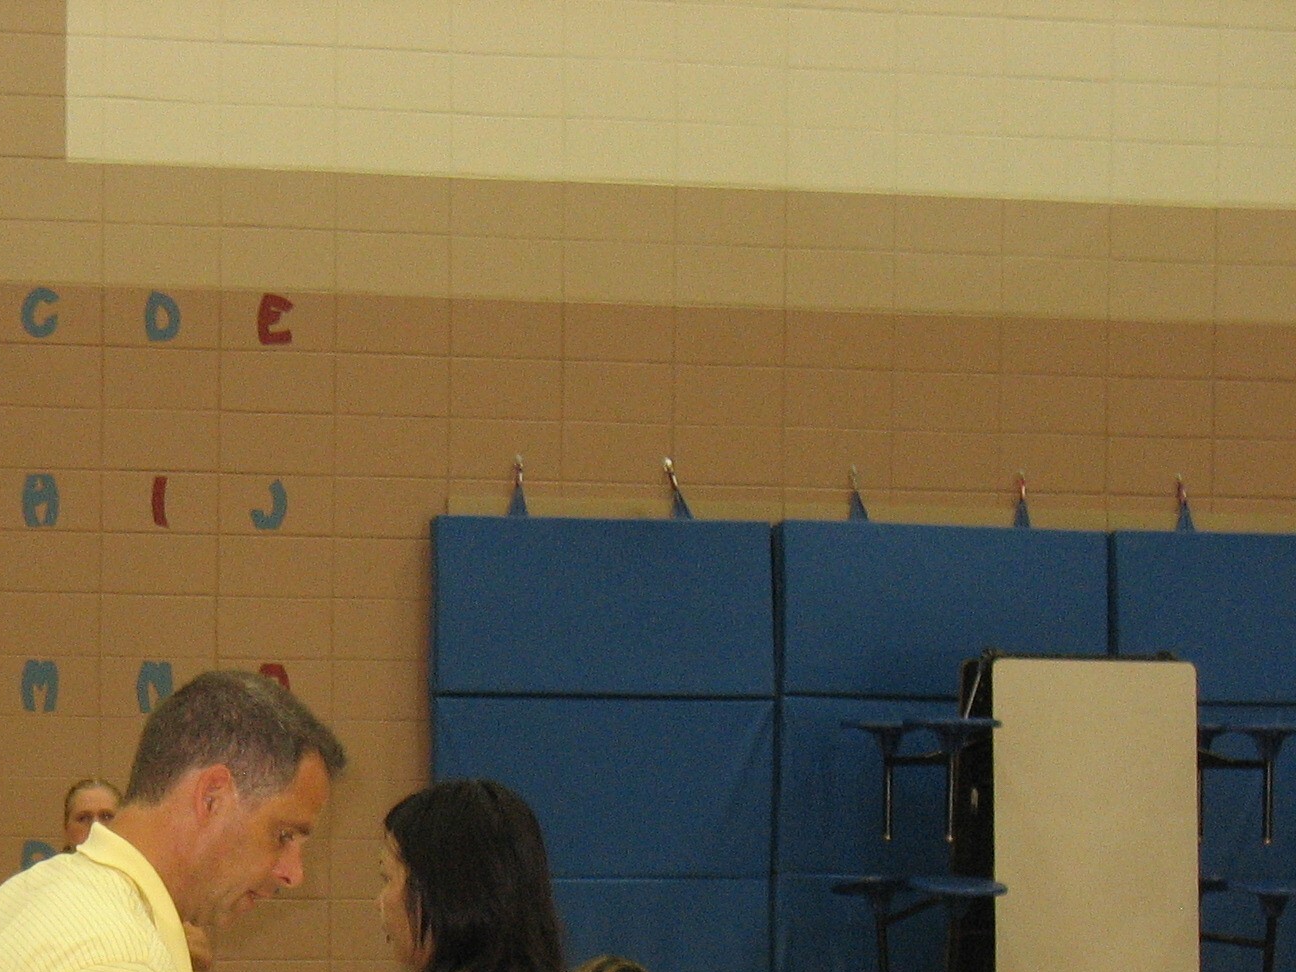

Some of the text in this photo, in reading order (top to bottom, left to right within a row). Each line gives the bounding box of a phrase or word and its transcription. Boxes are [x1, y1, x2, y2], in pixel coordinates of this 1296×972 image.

[21, 287, 58, 338] C
[144, 291, 181, 341] D
[258, 293, 292, 344] E
[22, 474, 59, 527] H
[152, 476, 168, 528] I
[250, 479, 287, 530] J
[21, 660, 59, 712] M
[137, 660, 173, 713] N
